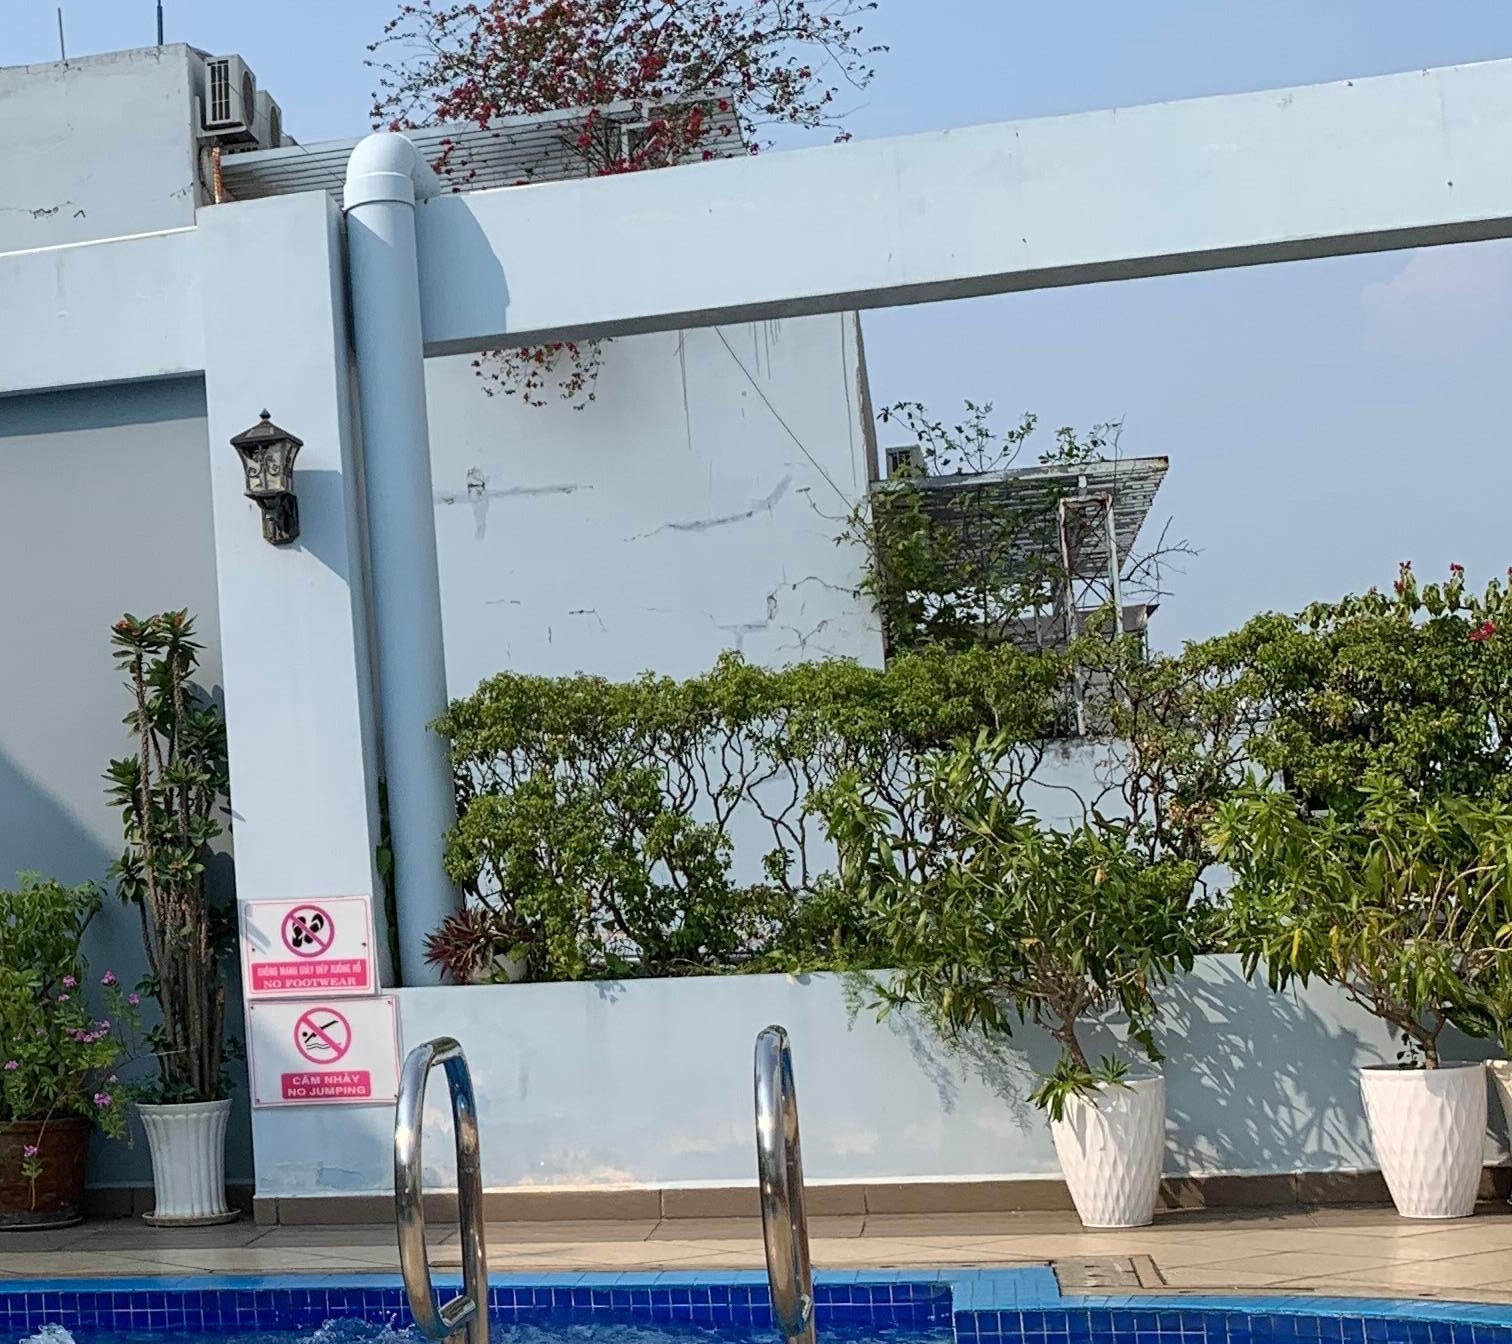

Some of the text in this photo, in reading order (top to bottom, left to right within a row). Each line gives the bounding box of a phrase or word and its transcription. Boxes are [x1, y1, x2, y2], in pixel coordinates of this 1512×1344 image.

[256, 964, 278, 976] KHÔNG
[279, 965, 298, 976] MANG
[263, 976, 357, 989] NO FOOTWEAR
[287, 1085, 366, 1096] NO JUMPING
